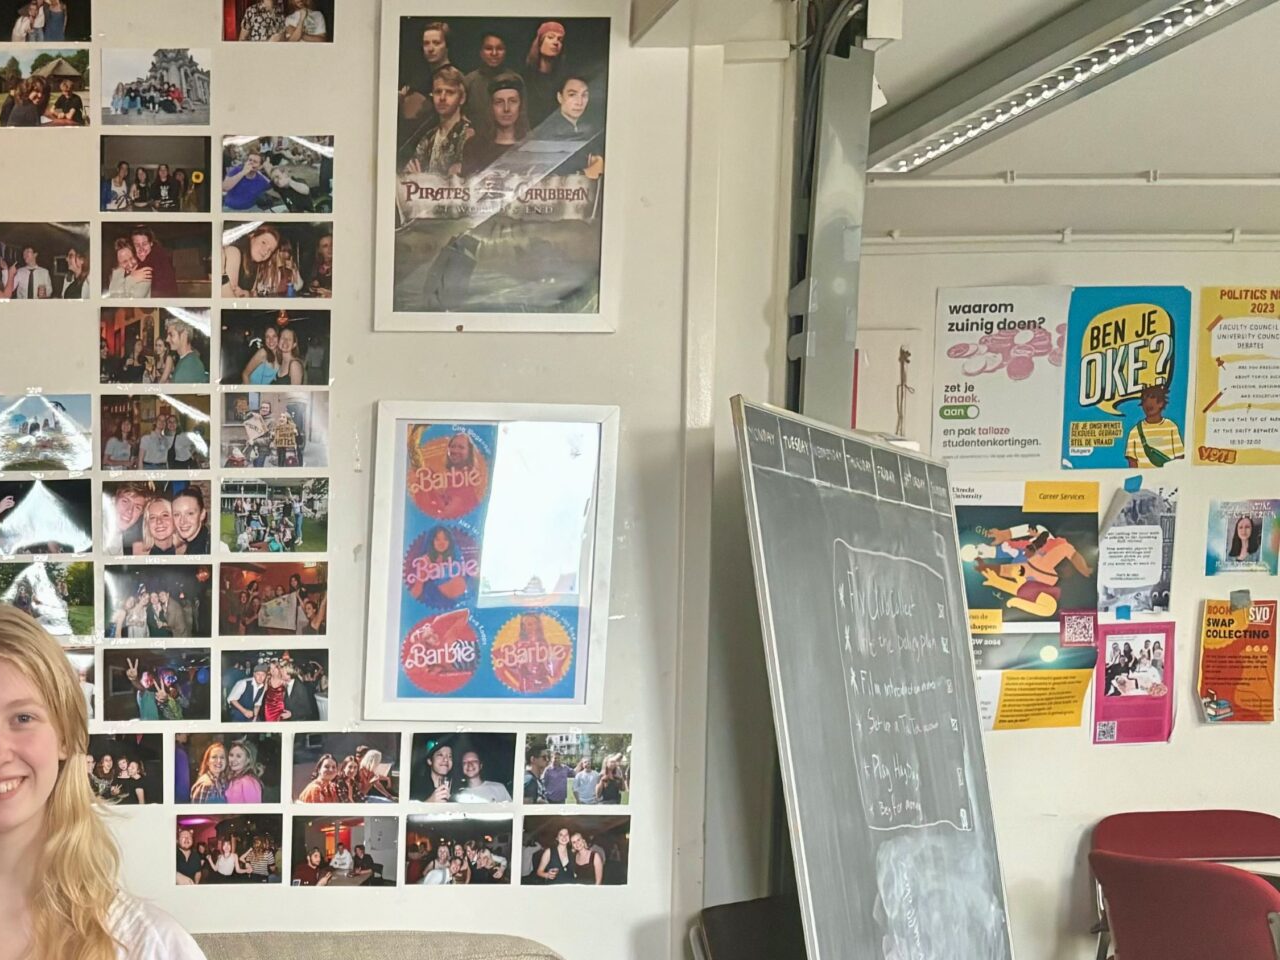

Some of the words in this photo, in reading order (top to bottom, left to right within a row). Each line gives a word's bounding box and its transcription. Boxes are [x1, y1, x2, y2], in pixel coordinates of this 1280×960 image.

[401, 180, 471, 201] PIRATES
[1220, 289, 1267, 300] POLITICS
[948, 302, 1014, 315] waarom
[1250, 302, 1275, 314] 2023
[947, 318, 994, 335] zuinig
[996, 316, 1046, 331] doen?
[1090, 318, 1126, 351] BEN
[1134, 310, 1158, 338] JE
[1237, 342, 1264, 350] DEBATES
[1079, 332, 1173, 408] OKE?
[944, 383, 961, 393] zet
[963, 382, 975, 394] je
[943, 394, 981, 404] knaek.
[943, 408, 965, 416] aan
[958, 426, 976, 438] pak
[978, 426, 1010, 436] talloze
[783, 435, 809, 456] TUESDAY
[942, 437, 1042, 449] studentenkortingen.
[1198, 446, 1237, 465] VOTE
[410, 465, 482, 494] Barbie
[1060, 492, 1086, 500] Services
[406, 555, 479, 584] Barbie
[1248, 606, 1270, 621] SVO
[1206, 618, 1235, 628] SWAP
[1205, 629, 1270, 639] COLLECTING
[405, 641, 476, 669] Barbie
[495, 640, 567, 668] Barbie
